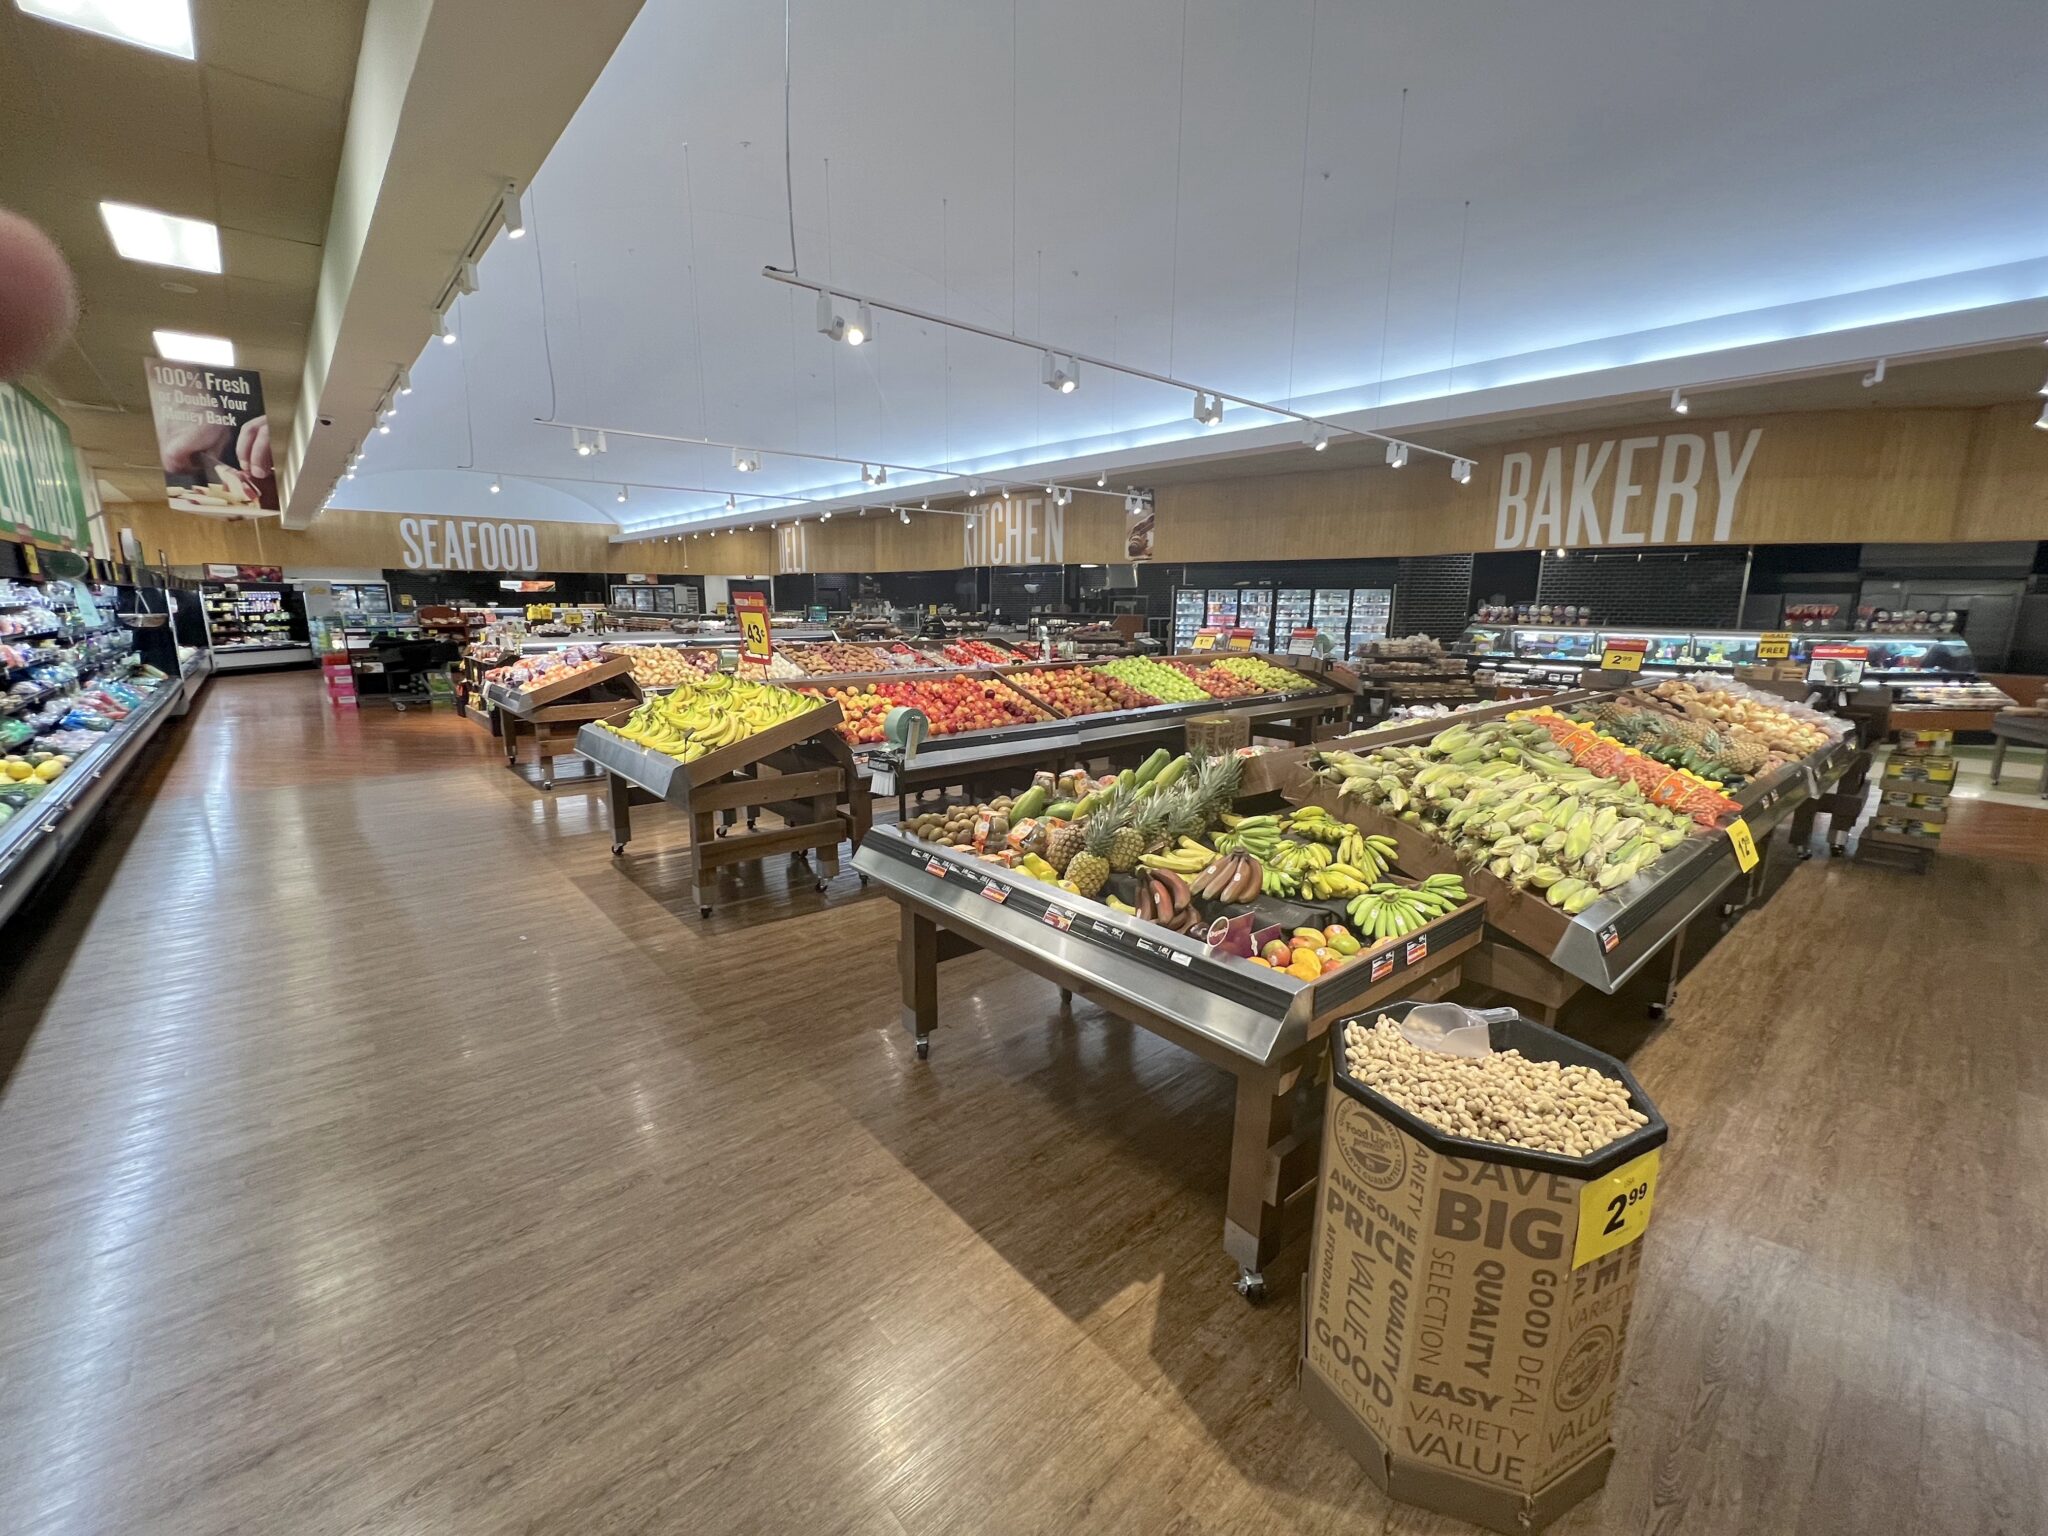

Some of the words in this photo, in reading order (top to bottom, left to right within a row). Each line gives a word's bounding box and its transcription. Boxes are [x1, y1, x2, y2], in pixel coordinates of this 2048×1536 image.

[154, 366, 202, 390] 100%
[205, 372, 250, 395] Fresh
[174, 390, 219, 409] Double
[219, 395, 248, 412] Your
[206, 411, 237, 427] Back
[1494, 428, 1763, 549] BAKERY
[400, 518, 539, 571] SEAFOOD
[778, 526, 806, 574] DELI
[963, 498, 1064, 566] KITCHEN
[1760, 646, 1786, 655] FREE
[1345, 1121, 1370, 1142] Food
[1370, 1132, 1392, 1150] Lion
[1330, 1167, 1419, 1246] AWESOME
[1407, 1143, 1430, 1221] ARIETY
[1443, 1154, 1574, 1204] SAVE
[1326, 1187, 1415, 1281] PRICE
[1434, 1188, 1564, 1260] BIG
[1318, 1222, 1337, 1315] AFFORDABLE
[1343, 1250, 1376, 1351] VALUE
[1382, 1279, 1409, 1383] QUALITY
[1418, 1248, 1455, 1366] SELECTION
[1464, 1259, 1506, 1380] QUALITY
[1522, 1269, 1558, 1349] GOOD
[1311, 1345, 1392, 1438] SELECTION
[1315, 1317, 1394, 1407] GOOD
[1412, 1373, 1504, 1413] EASY
[1510, 1356, 1544, 1417] DEAL
[1404, 1426, 1526, 1485] VALUE
[1409, 1401, 1530, 1450] VARIETY
